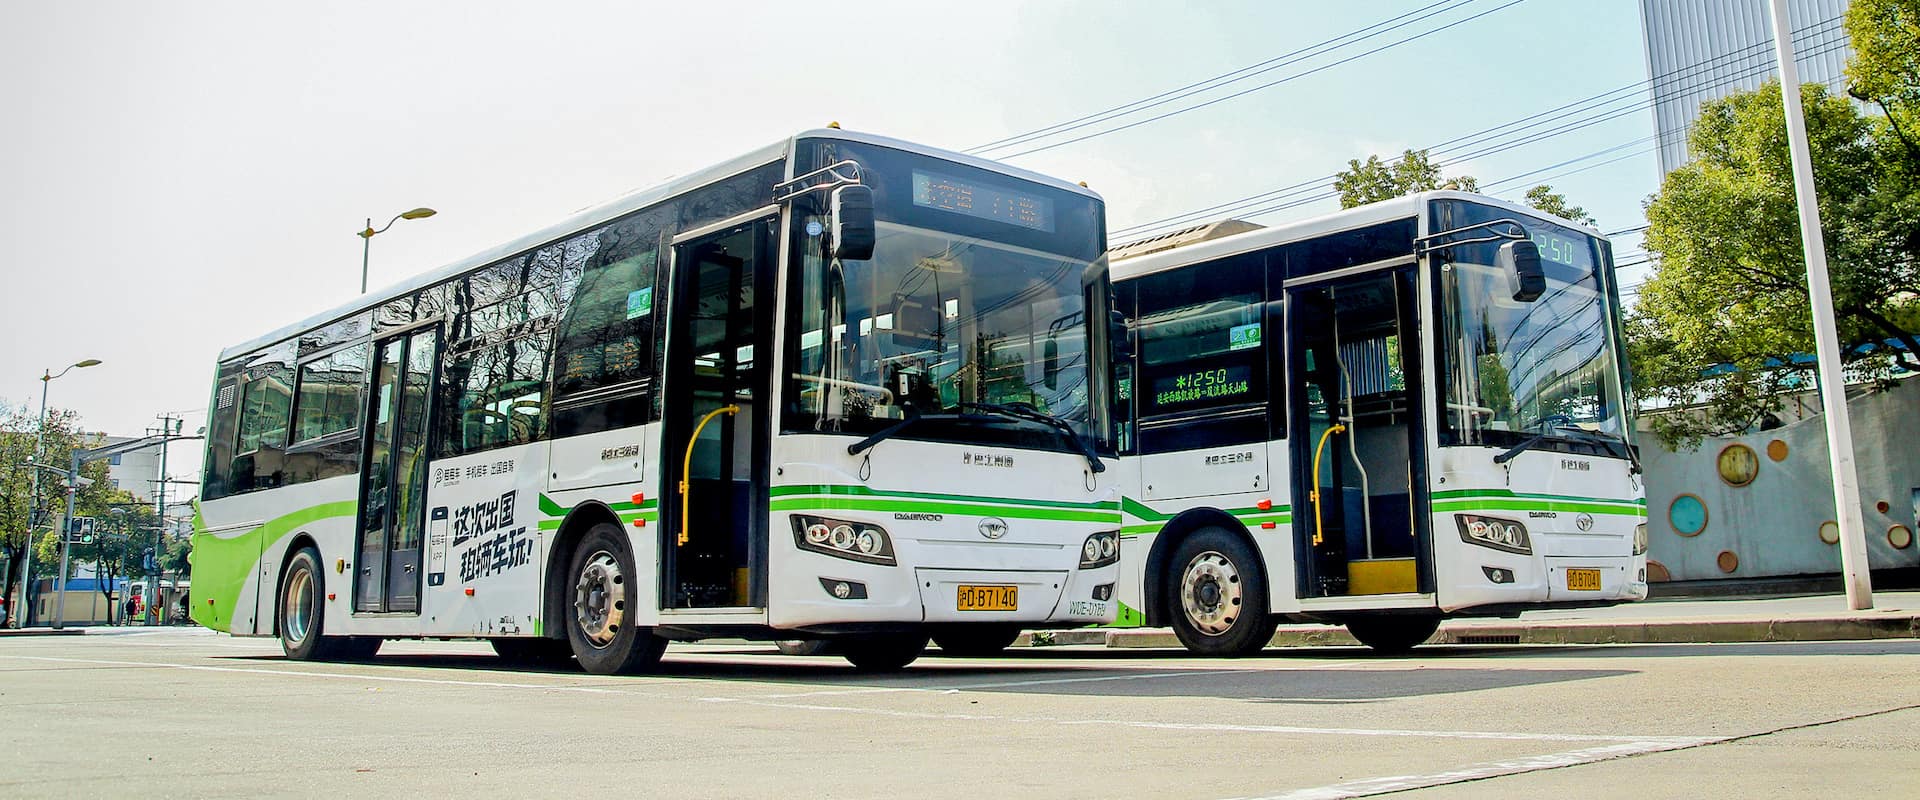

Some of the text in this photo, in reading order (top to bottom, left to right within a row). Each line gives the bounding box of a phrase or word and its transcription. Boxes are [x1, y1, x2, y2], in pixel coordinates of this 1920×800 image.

[452, 489, 517, 547] 这次出国
[894, 512, 943, 522] DAEWOO
